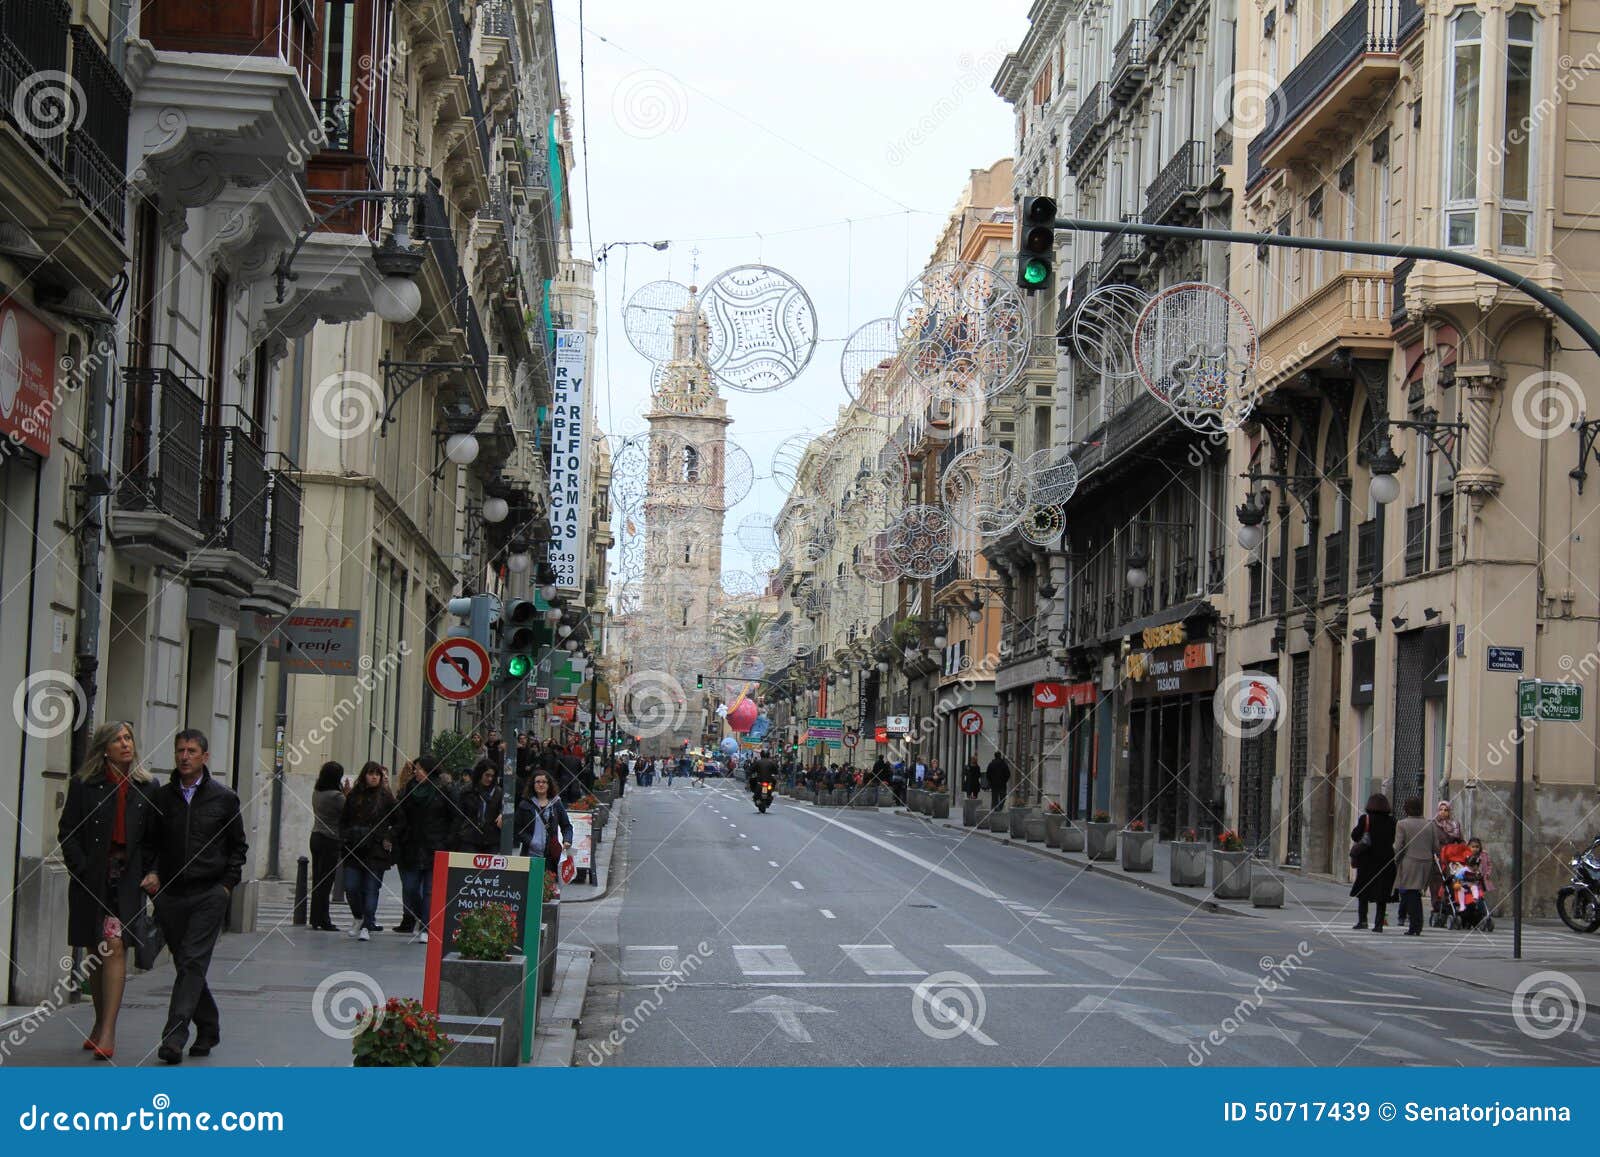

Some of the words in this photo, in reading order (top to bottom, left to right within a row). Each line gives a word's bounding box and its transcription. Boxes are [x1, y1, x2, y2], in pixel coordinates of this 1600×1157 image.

[571, 378, 582, 392] Y
[549, 367, 568, 550] REHABILITACION
[565, 405, 581, 539] REFORMAS
[288, 616, 342, 628] IBERIA
[298, 638, 341, 654] renfe
[464, 874, 500, 887] CAFÉ
